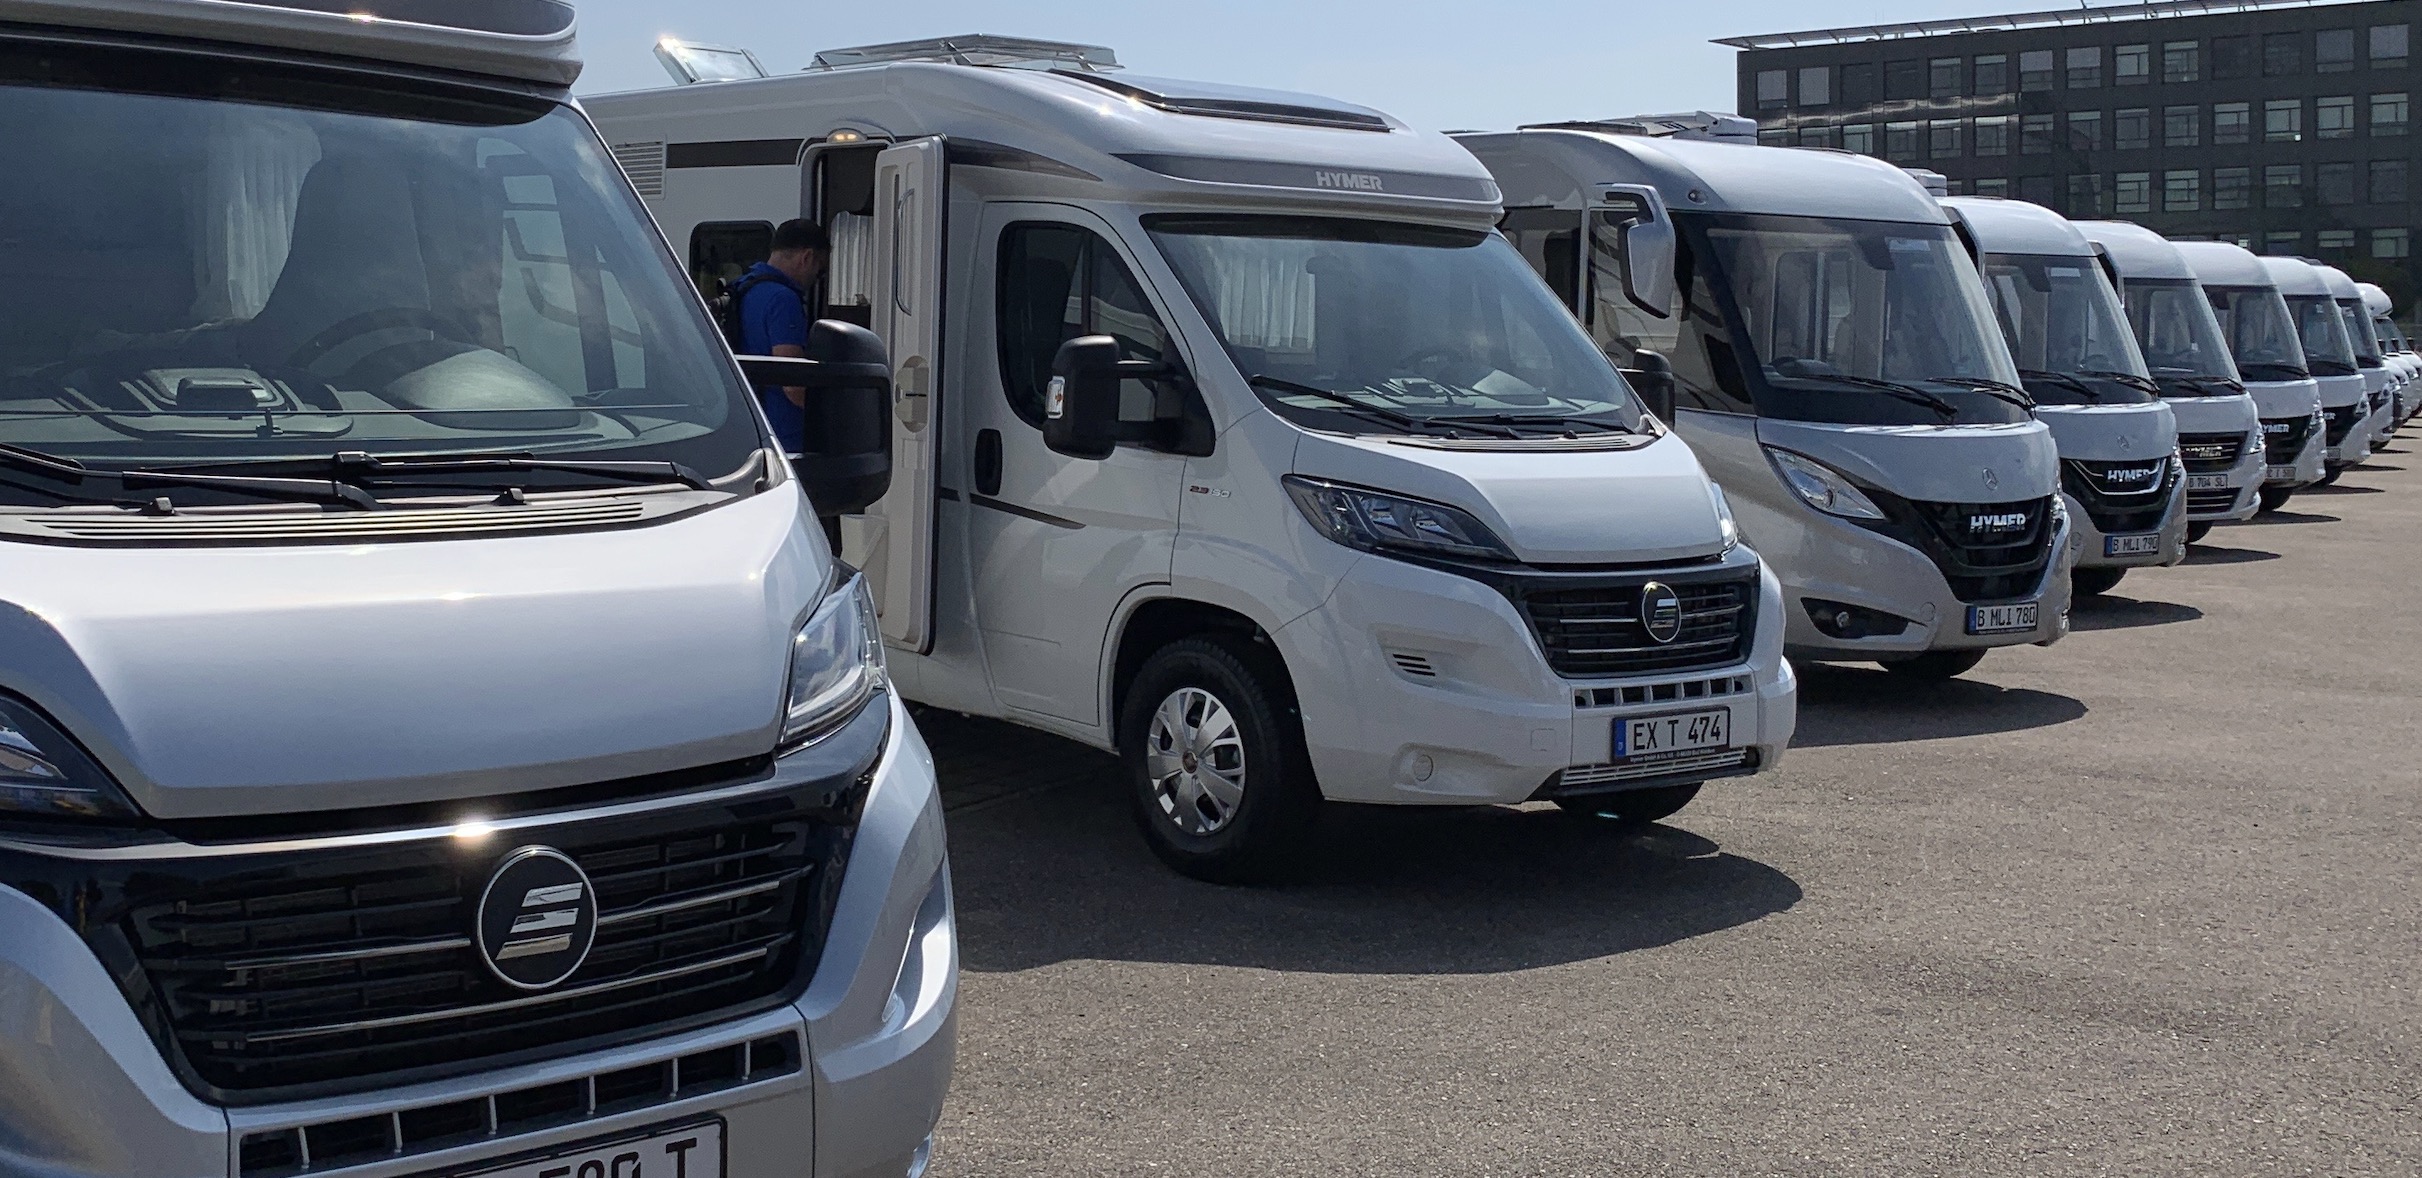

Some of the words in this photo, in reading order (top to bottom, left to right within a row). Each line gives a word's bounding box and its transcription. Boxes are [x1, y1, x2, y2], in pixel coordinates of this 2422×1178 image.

[1315, 170, 1384, 191] HYMER
[2260, 423, 2290, 434] YMER
[1970, 513, 2026, 532] HYMER
[2113, 538, 2120, 552] B
[1977, 609, 1985, 628] B
[1990, 608, 2012, 627] MLI
[2016, 606, 2036, 625] 780
[1633, 721, 1658, 751] EX
[1667, 719, 1679, 747] T
[1688, 714, 1721, 744] 474
